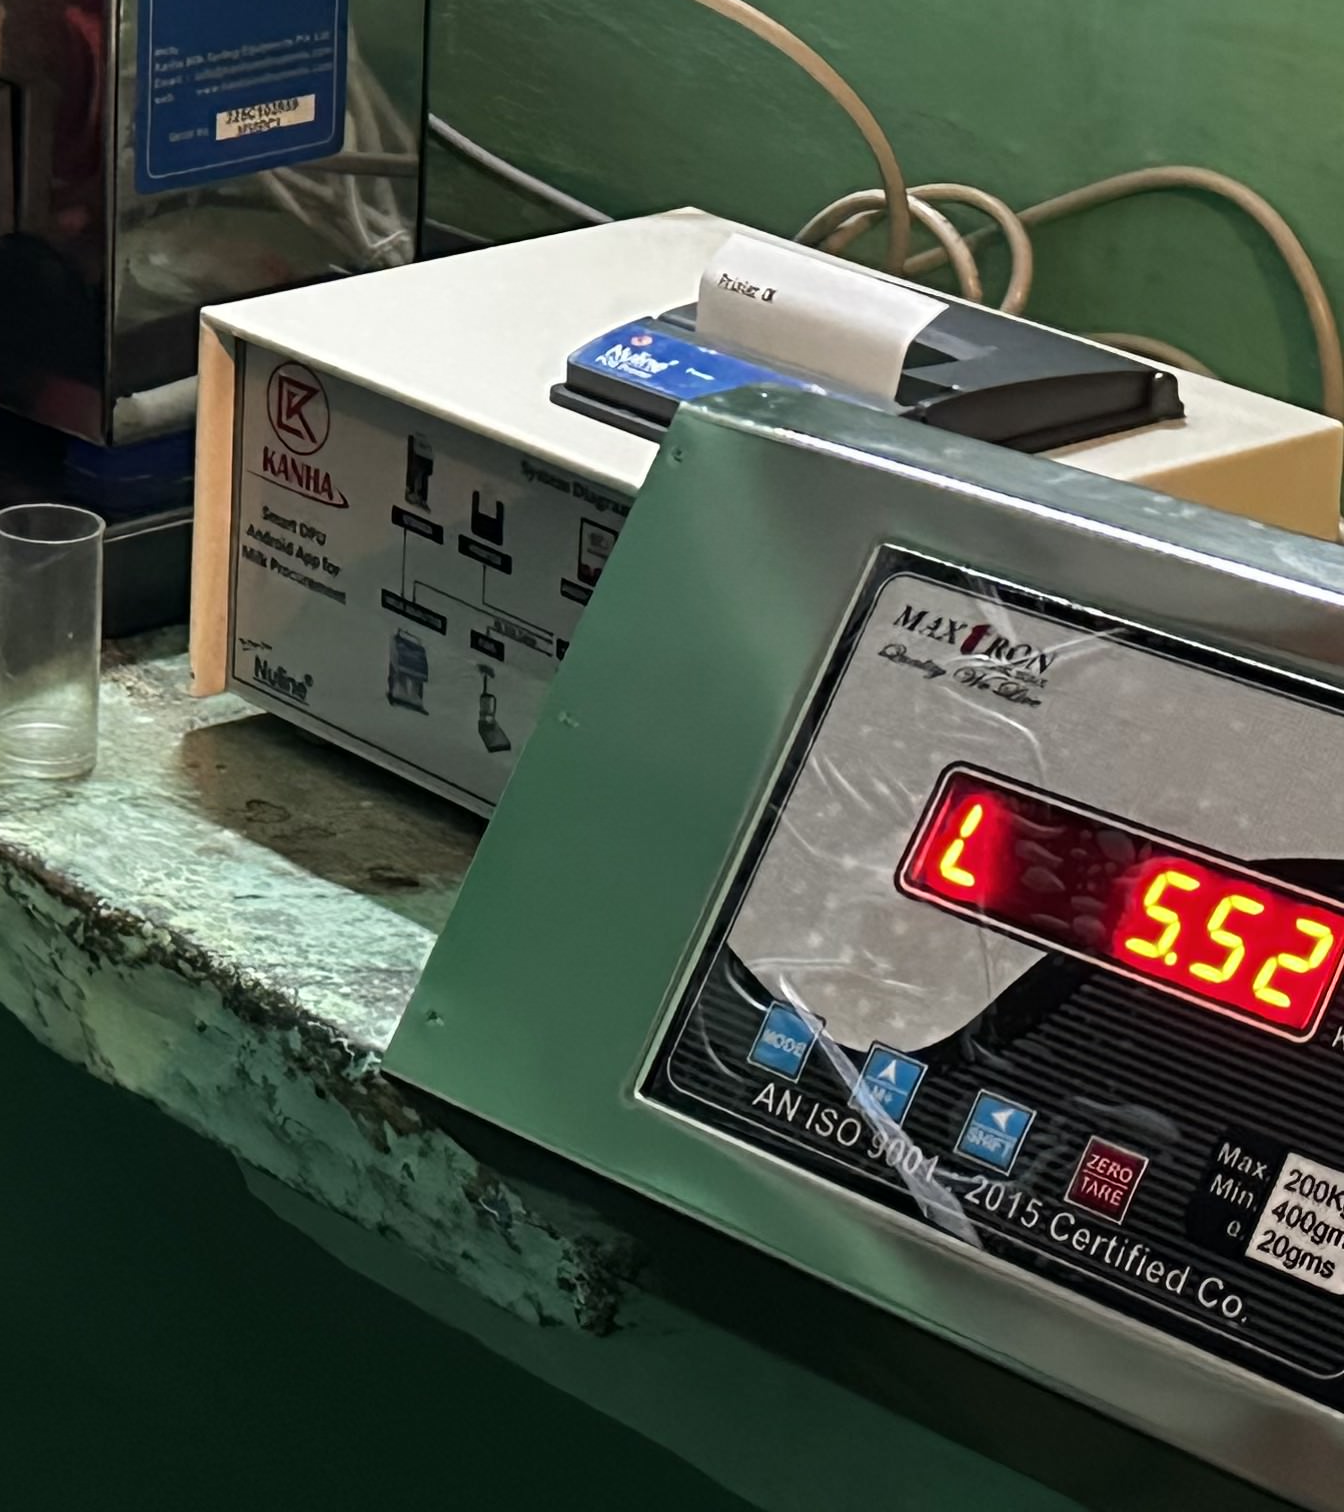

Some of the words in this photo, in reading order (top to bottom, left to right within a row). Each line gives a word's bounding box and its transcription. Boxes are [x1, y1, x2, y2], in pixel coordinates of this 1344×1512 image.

[263, 446, 334, 501] KANHA
[1124, 869, 1334, 1009] 5.52
[763, 1028, 805, 1058] MODE
[967, 1129, 1012, 1159] SHIFT
[1086, 1153, 1133, 1184] ZERO
[752, 1082, 802, 1122] AN
[805, 1102, 861, 1146] ISO
[867, 1131, 940, 1181] 9001
[964, 1174, 1043, 1228] 2015
[1049, 1211, 1190, 1295] Certified
[1197, 1276, 1248, 1324] Co.
[1079, 1176, 1124, 1207] TARE
[1256, 1229, 1336, 1279] 20gms
